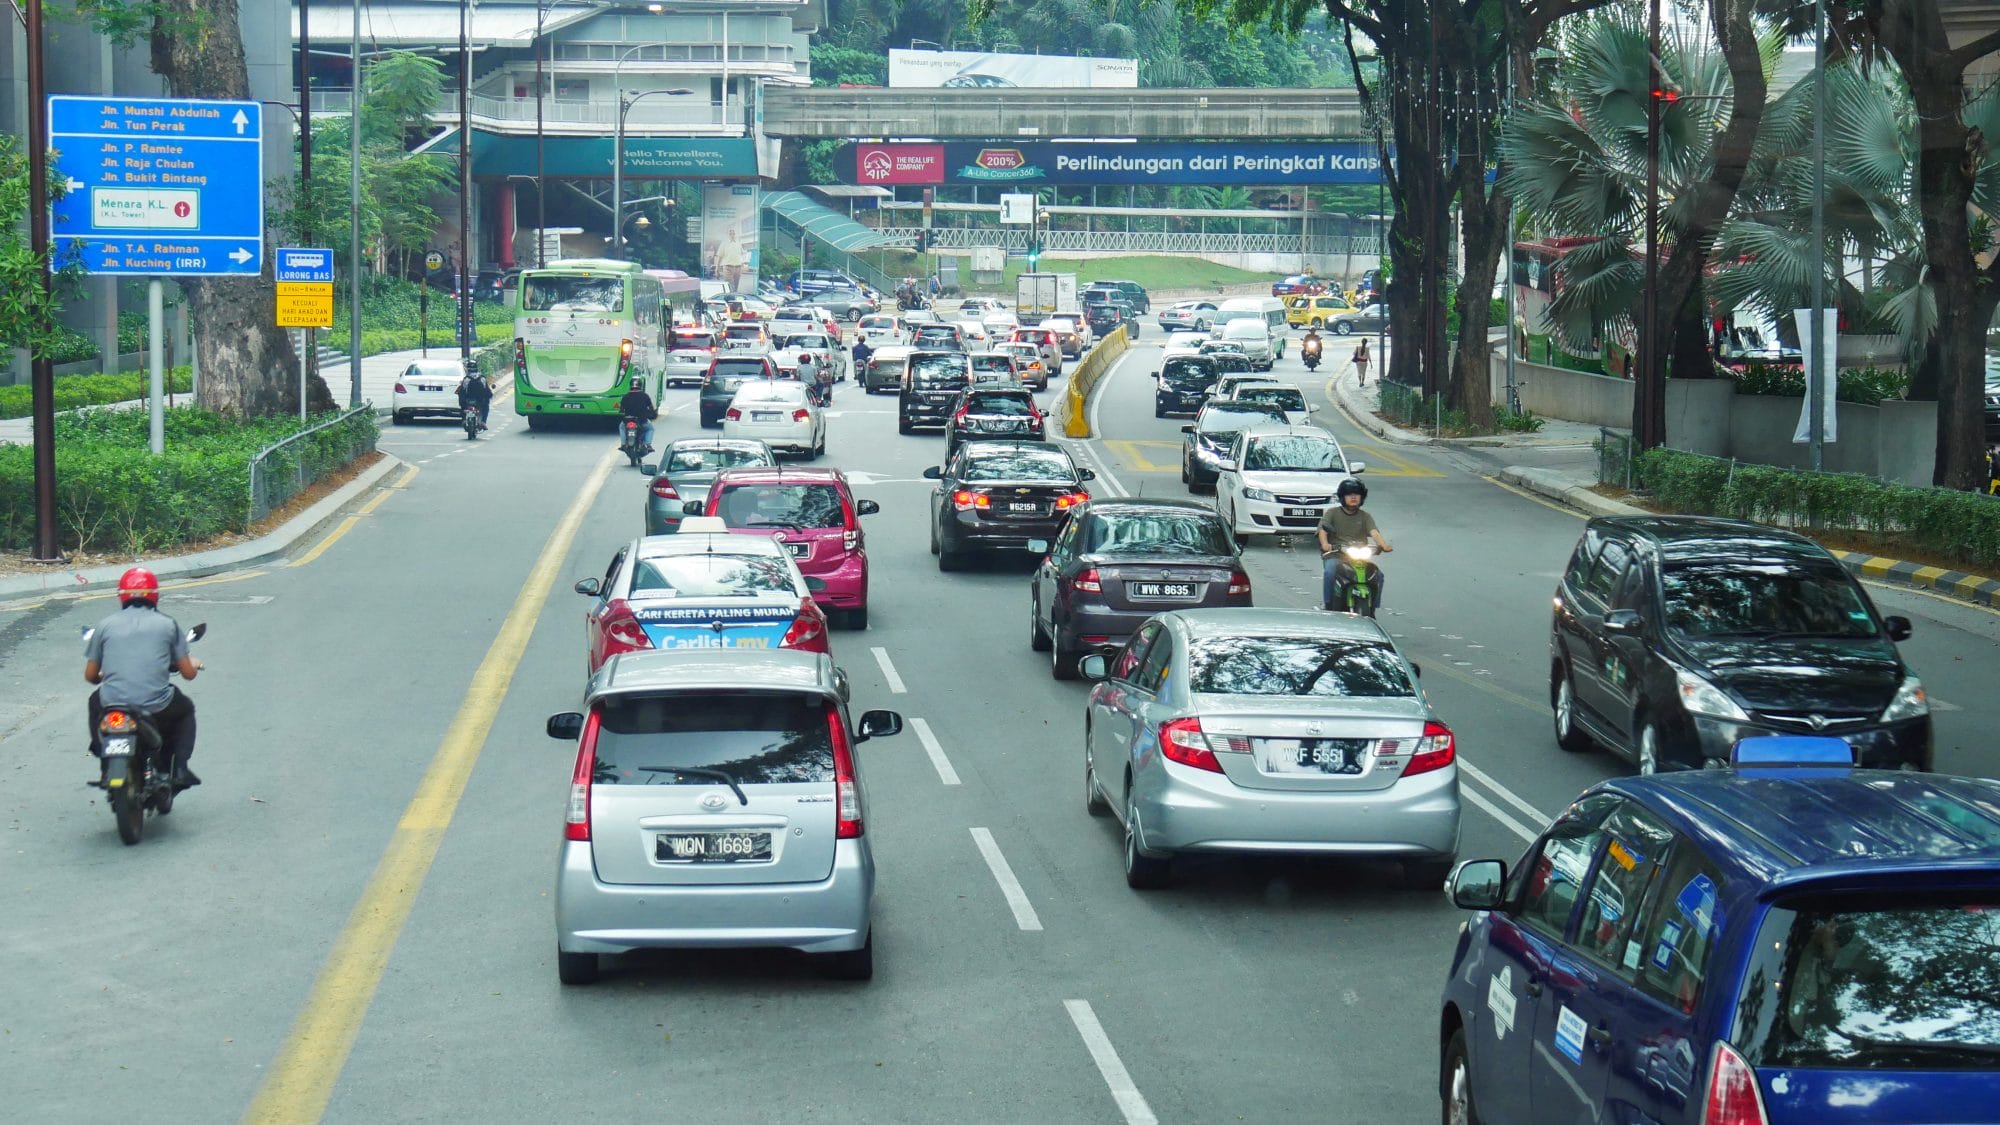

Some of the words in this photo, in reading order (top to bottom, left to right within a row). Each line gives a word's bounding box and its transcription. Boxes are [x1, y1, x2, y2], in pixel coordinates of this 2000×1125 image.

[101, 105, 119, 115] Jln.
[124, 106, 164, 116] Munshi
[170, 107, 220, 118] Abdullah
[101, 119, 119, 129] Jln.
[125, 120, 147, 130] Tun
[152, 121, 185, 131] Perak
[101, 143, 119, 153] Jln.
[125, 143, 136, 153] P.
[141, 144, 183, 154] Ramlee
[655, 150, 723, 158] Travellers,
[101, 158, 120, 167] Jln.
[125, 158, 150, 170] Raja
[156, 159, 194, 169] Chulan
[696, 159, 724, 167] You.
[987, 157, 1016, 166] 200%
[1056, 155, 1183, 174] Perlindungan
[1189, 155, 1227, 170] dari
[1234, 156, 1325, 174] Peringkat
[1331, 155, 1397, 170] Kansr
[101, 172, 120, 182] Jln.
[125, 172, 157, 182] Bukit
[162, 173, 207, 186] Bintang
[866, 170, 890, 179] AIA
[101, 199, 142, 209] Menara
[148, 200, 169, 209] K.L.
[102, 244, 120, 253] Jln.
[126, 244, 149, 253] T.A.
[154, 244, 199, 254] Rahman
[102, 258, 120, 267] Jln.
[126, 258, 171, 270] Kuching
[175, 257, 206, 269] (IRR)
[280, 271, 310, 279] LORONG
[314, 272, 330, 280] BAS
[1141, 585, 1159, 594] WVK
[1164, 585, 1188, 595] 8635
[637, 609, 661, 619] CARI
[664, 609, 705, 619] KERETA
[709, 608, 751, 618] PALING
[754, 607, 794, 617] MURAH
[1312, 748, 1344, 764] 5551
[673, 837, 705, 854] WQN
[716, 837, 753, 854] 1669
